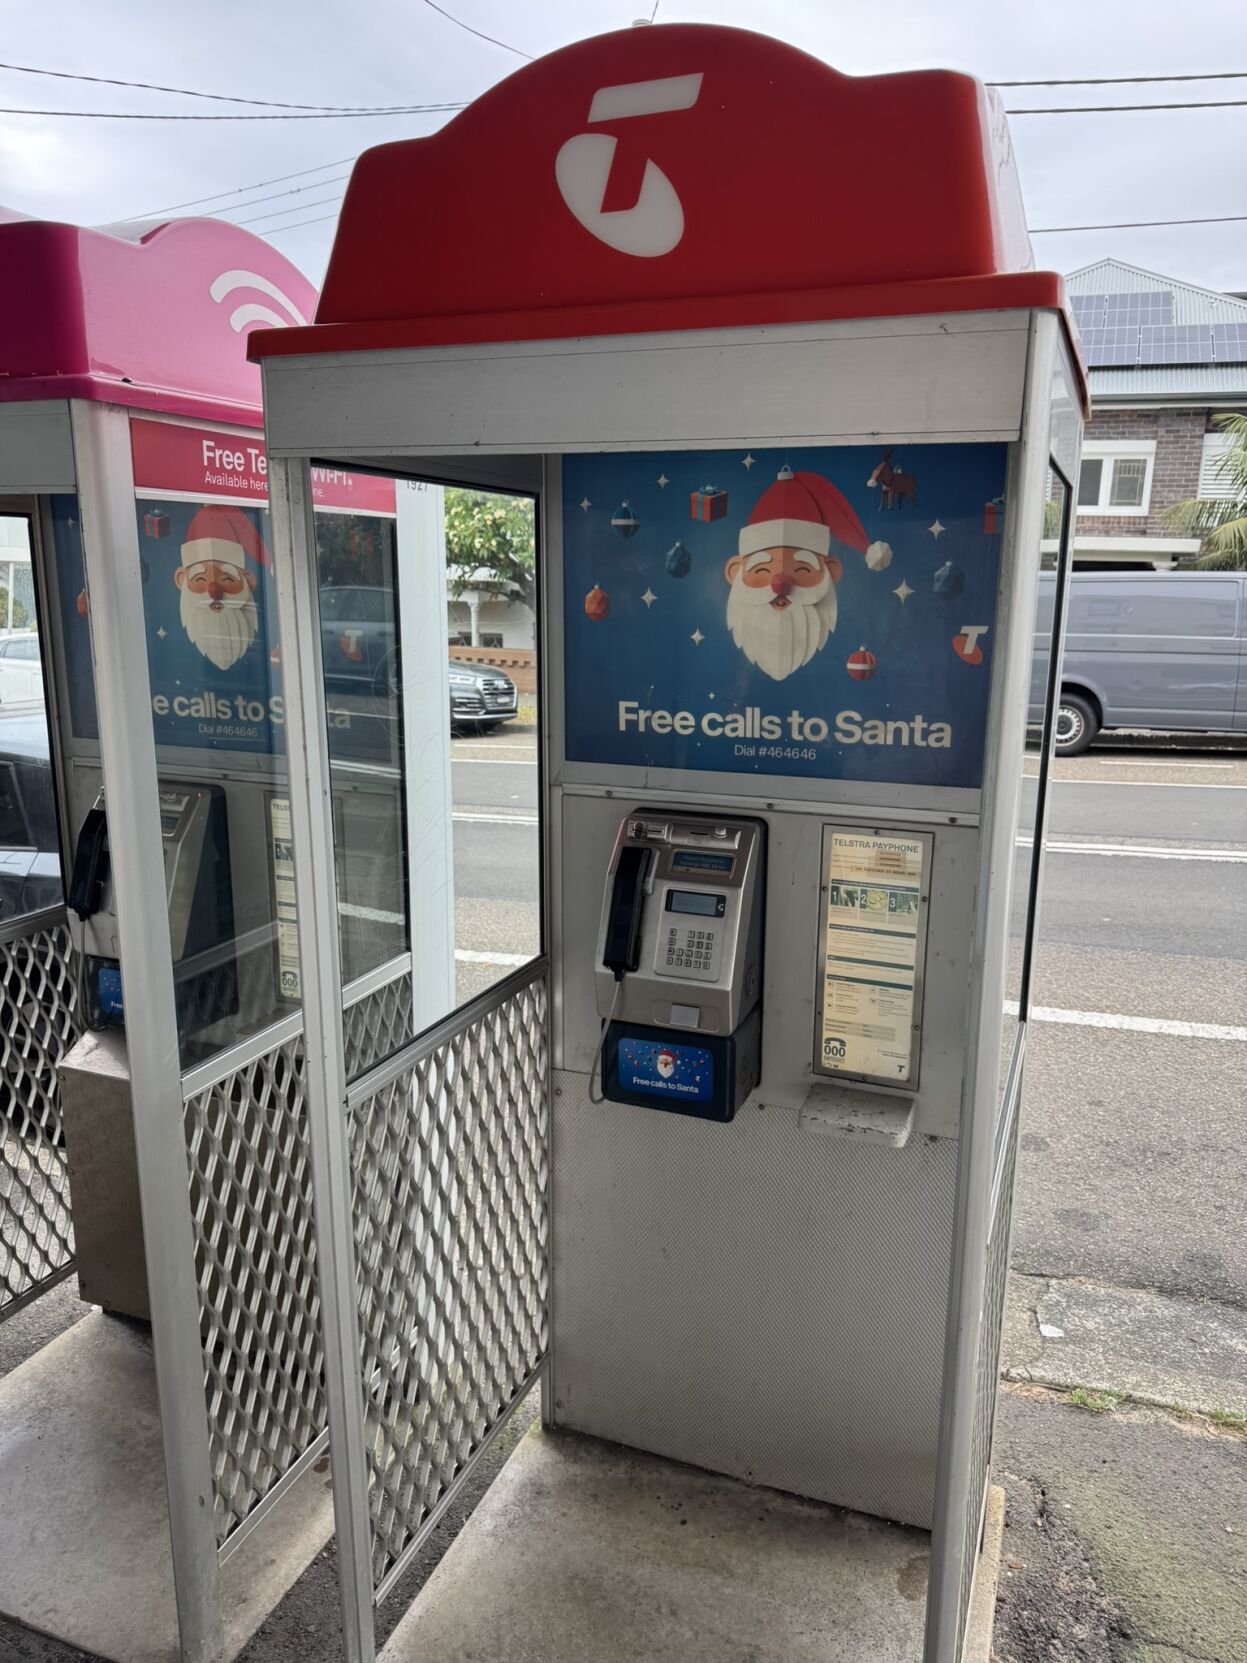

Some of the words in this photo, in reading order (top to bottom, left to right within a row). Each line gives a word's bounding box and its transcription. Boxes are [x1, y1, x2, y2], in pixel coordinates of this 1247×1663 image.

[202, 440, 245, 471] Free
[205, 471, 248, 488] Available
[173, 692, 232, 720] calls
[234, 695, 265, 722] to
[198, 723, 214, 734] Dial
[618, 701, 696, 735] Free
[701, 707, 782, 740] calls
[787, 710, 828, 743] to
[834, 710, 952, 748] Santa
[734, 744, 756, 757] Dial
[758, 745, 817, 761] #464646
[833, 838, 871, 848] TELSTRA
[872, 842, 920, 853] PAYPHONE
[833, 892, 838, 901] 1
[860, 894, 867, 905] 2
[889, 897, 896, 908] 3
[282, 977, 298, 987] 000
[824, 1045, 846, 1057] 000
[633, 1077, 650, 1086] Free
[651, 1079, 667, 1089] calls
[668, 1082, 676, 1090] to
[677, 1084, 699, 1093] Santa
